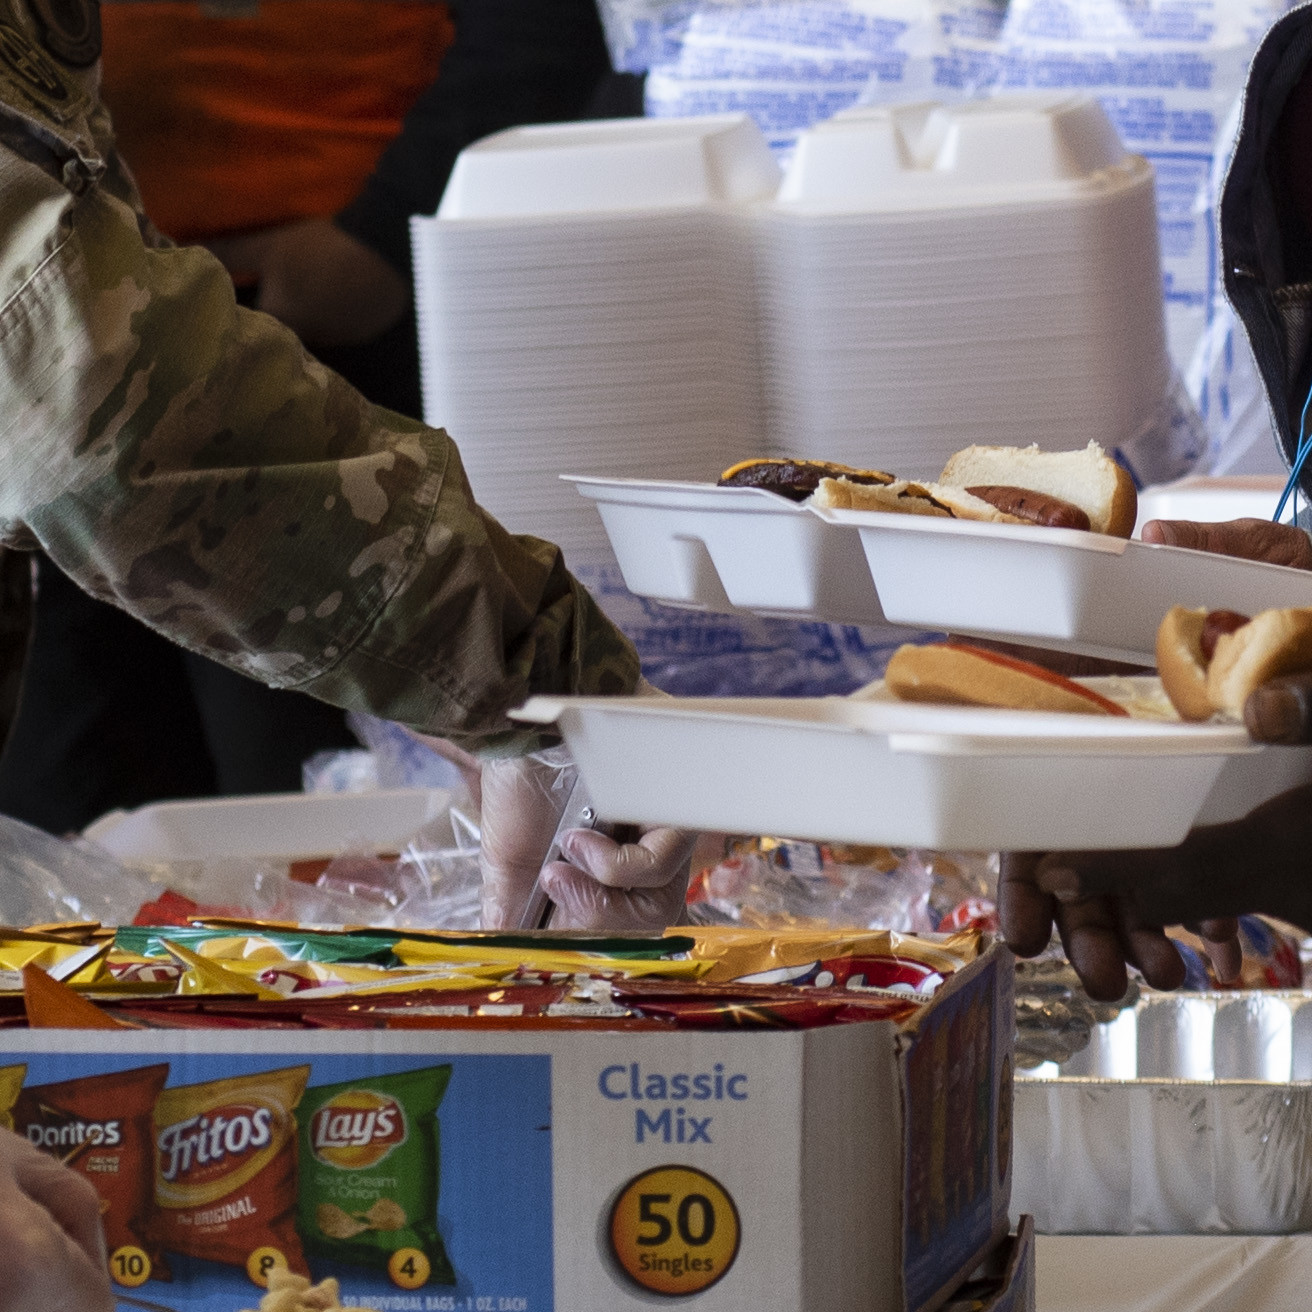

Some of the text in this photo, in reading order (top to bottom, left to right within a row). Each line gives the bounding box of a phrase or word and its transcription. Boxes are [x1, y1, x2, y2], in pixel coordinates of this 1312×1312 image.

[597, 1061, 749, 1101] Classic
[27, 1120, 120, 1147] Doritos
[315, 1106, 398, 1148] Lay's
[635, 1106, 714, 1145] Mix
[157, 1108, 272, 1181] Fritos
[347, 1173, 398, 1188] Cream
[193, 1196, 258, 1226] ORIGINAL
[636, 1193, 716, 1247] 50
[114, 1254, 144, 1277] 10
[260, 1255, 276, 1278] 8
[399, 1256, 417, 1278] 4
[639, 1253, 714, 1278] Singles
[359, 1296, 423, 1311] INDIVIDUAL
[425, 1296, 455, 1311] BAGS
[498, 1296, 528, 1311] EACH
